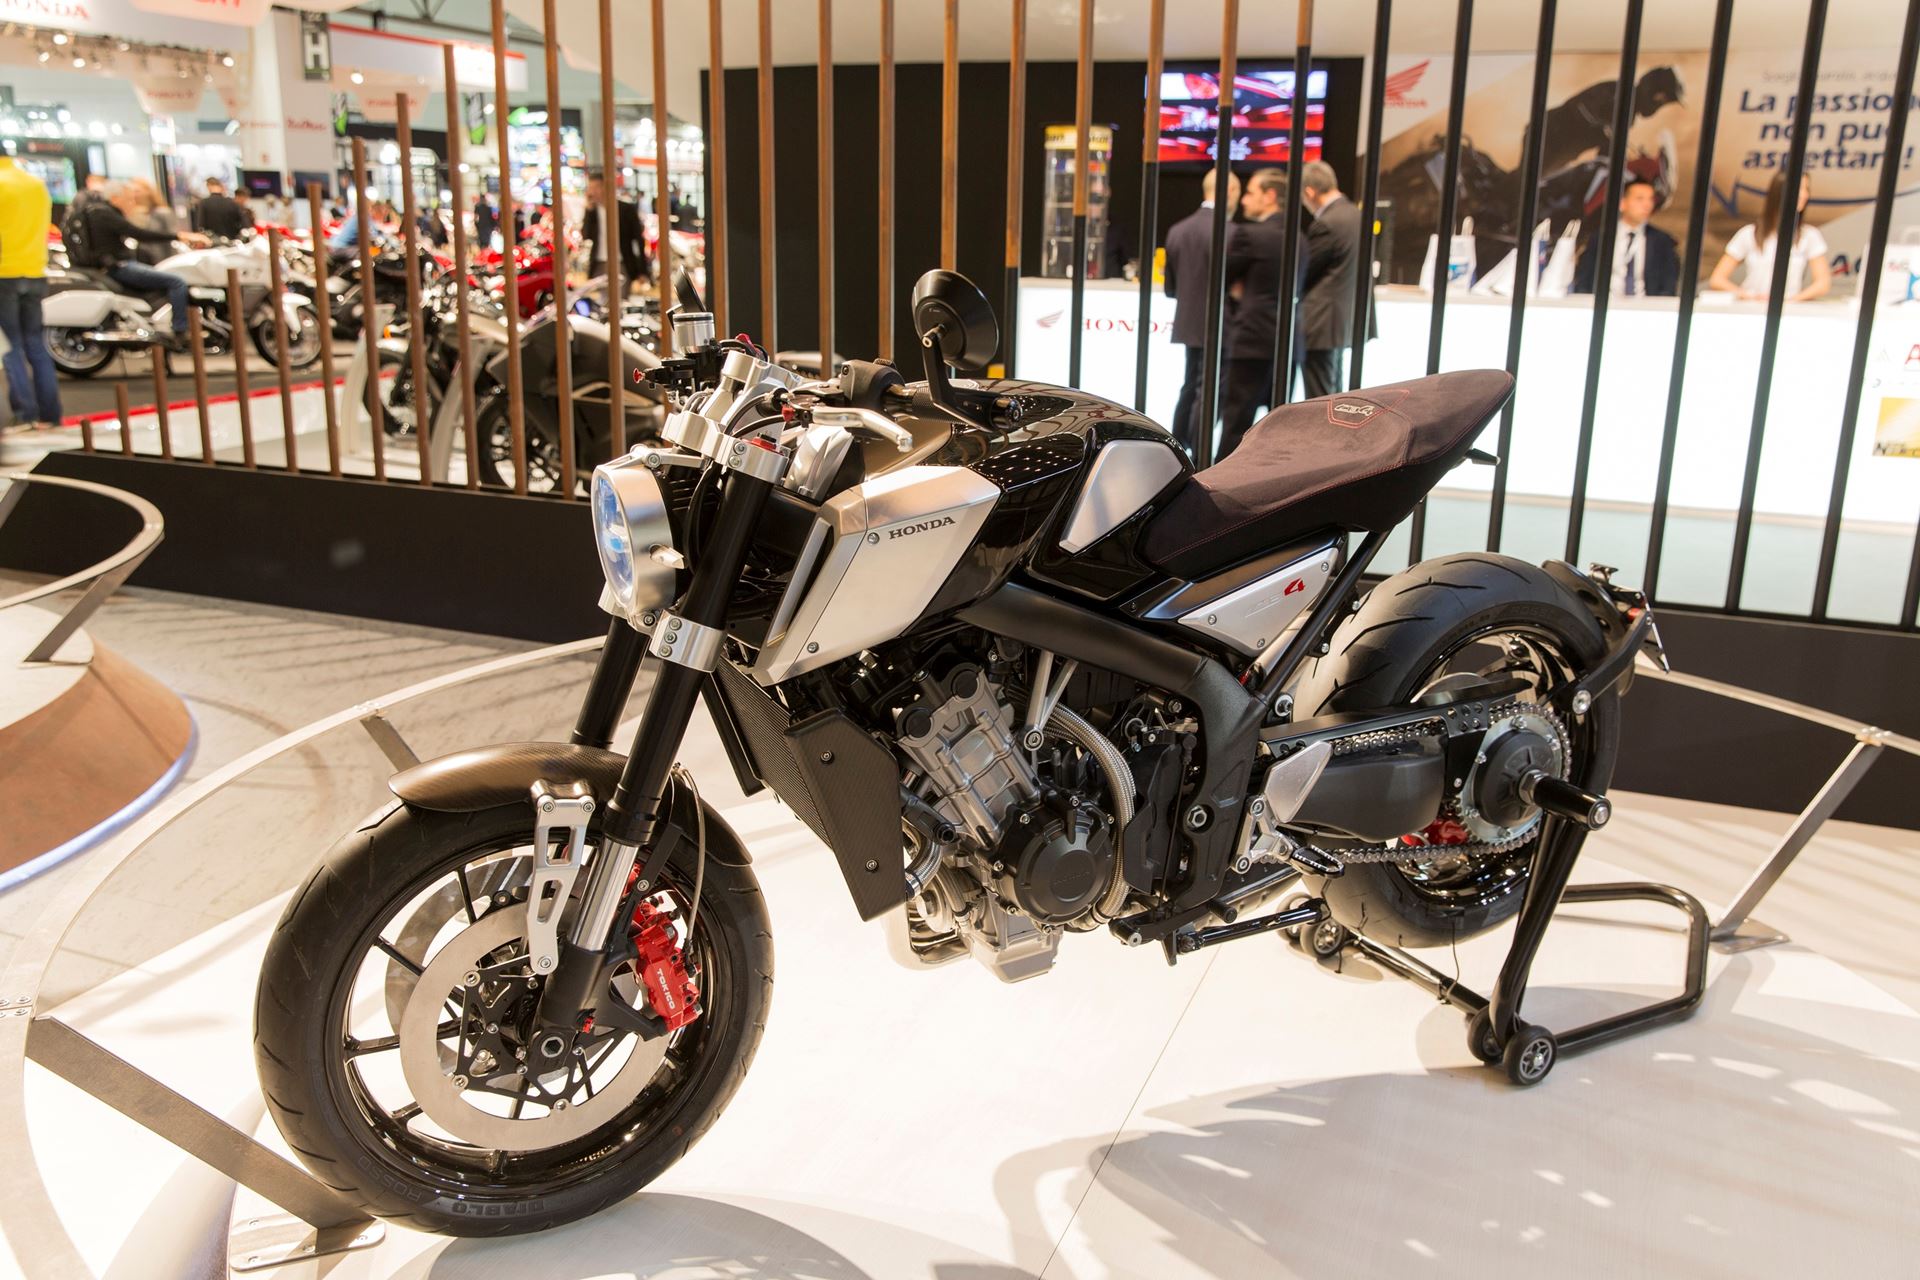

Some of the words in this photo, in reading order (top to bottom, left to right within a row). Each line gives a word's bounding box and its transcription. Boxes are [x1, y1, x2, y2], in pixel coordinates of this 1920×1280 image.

[304, 31, 330, 70] H
[1739, 90, 1776, 112] La
[1837, 123, 1891, 147] pu
[888, 516, 956, 540] HONDA
[656, 968, 676, 1010] TOKICO
[357, 1154, 423, 1203] ROSSO
[451, 1200, 545, 1217] DIABLO
